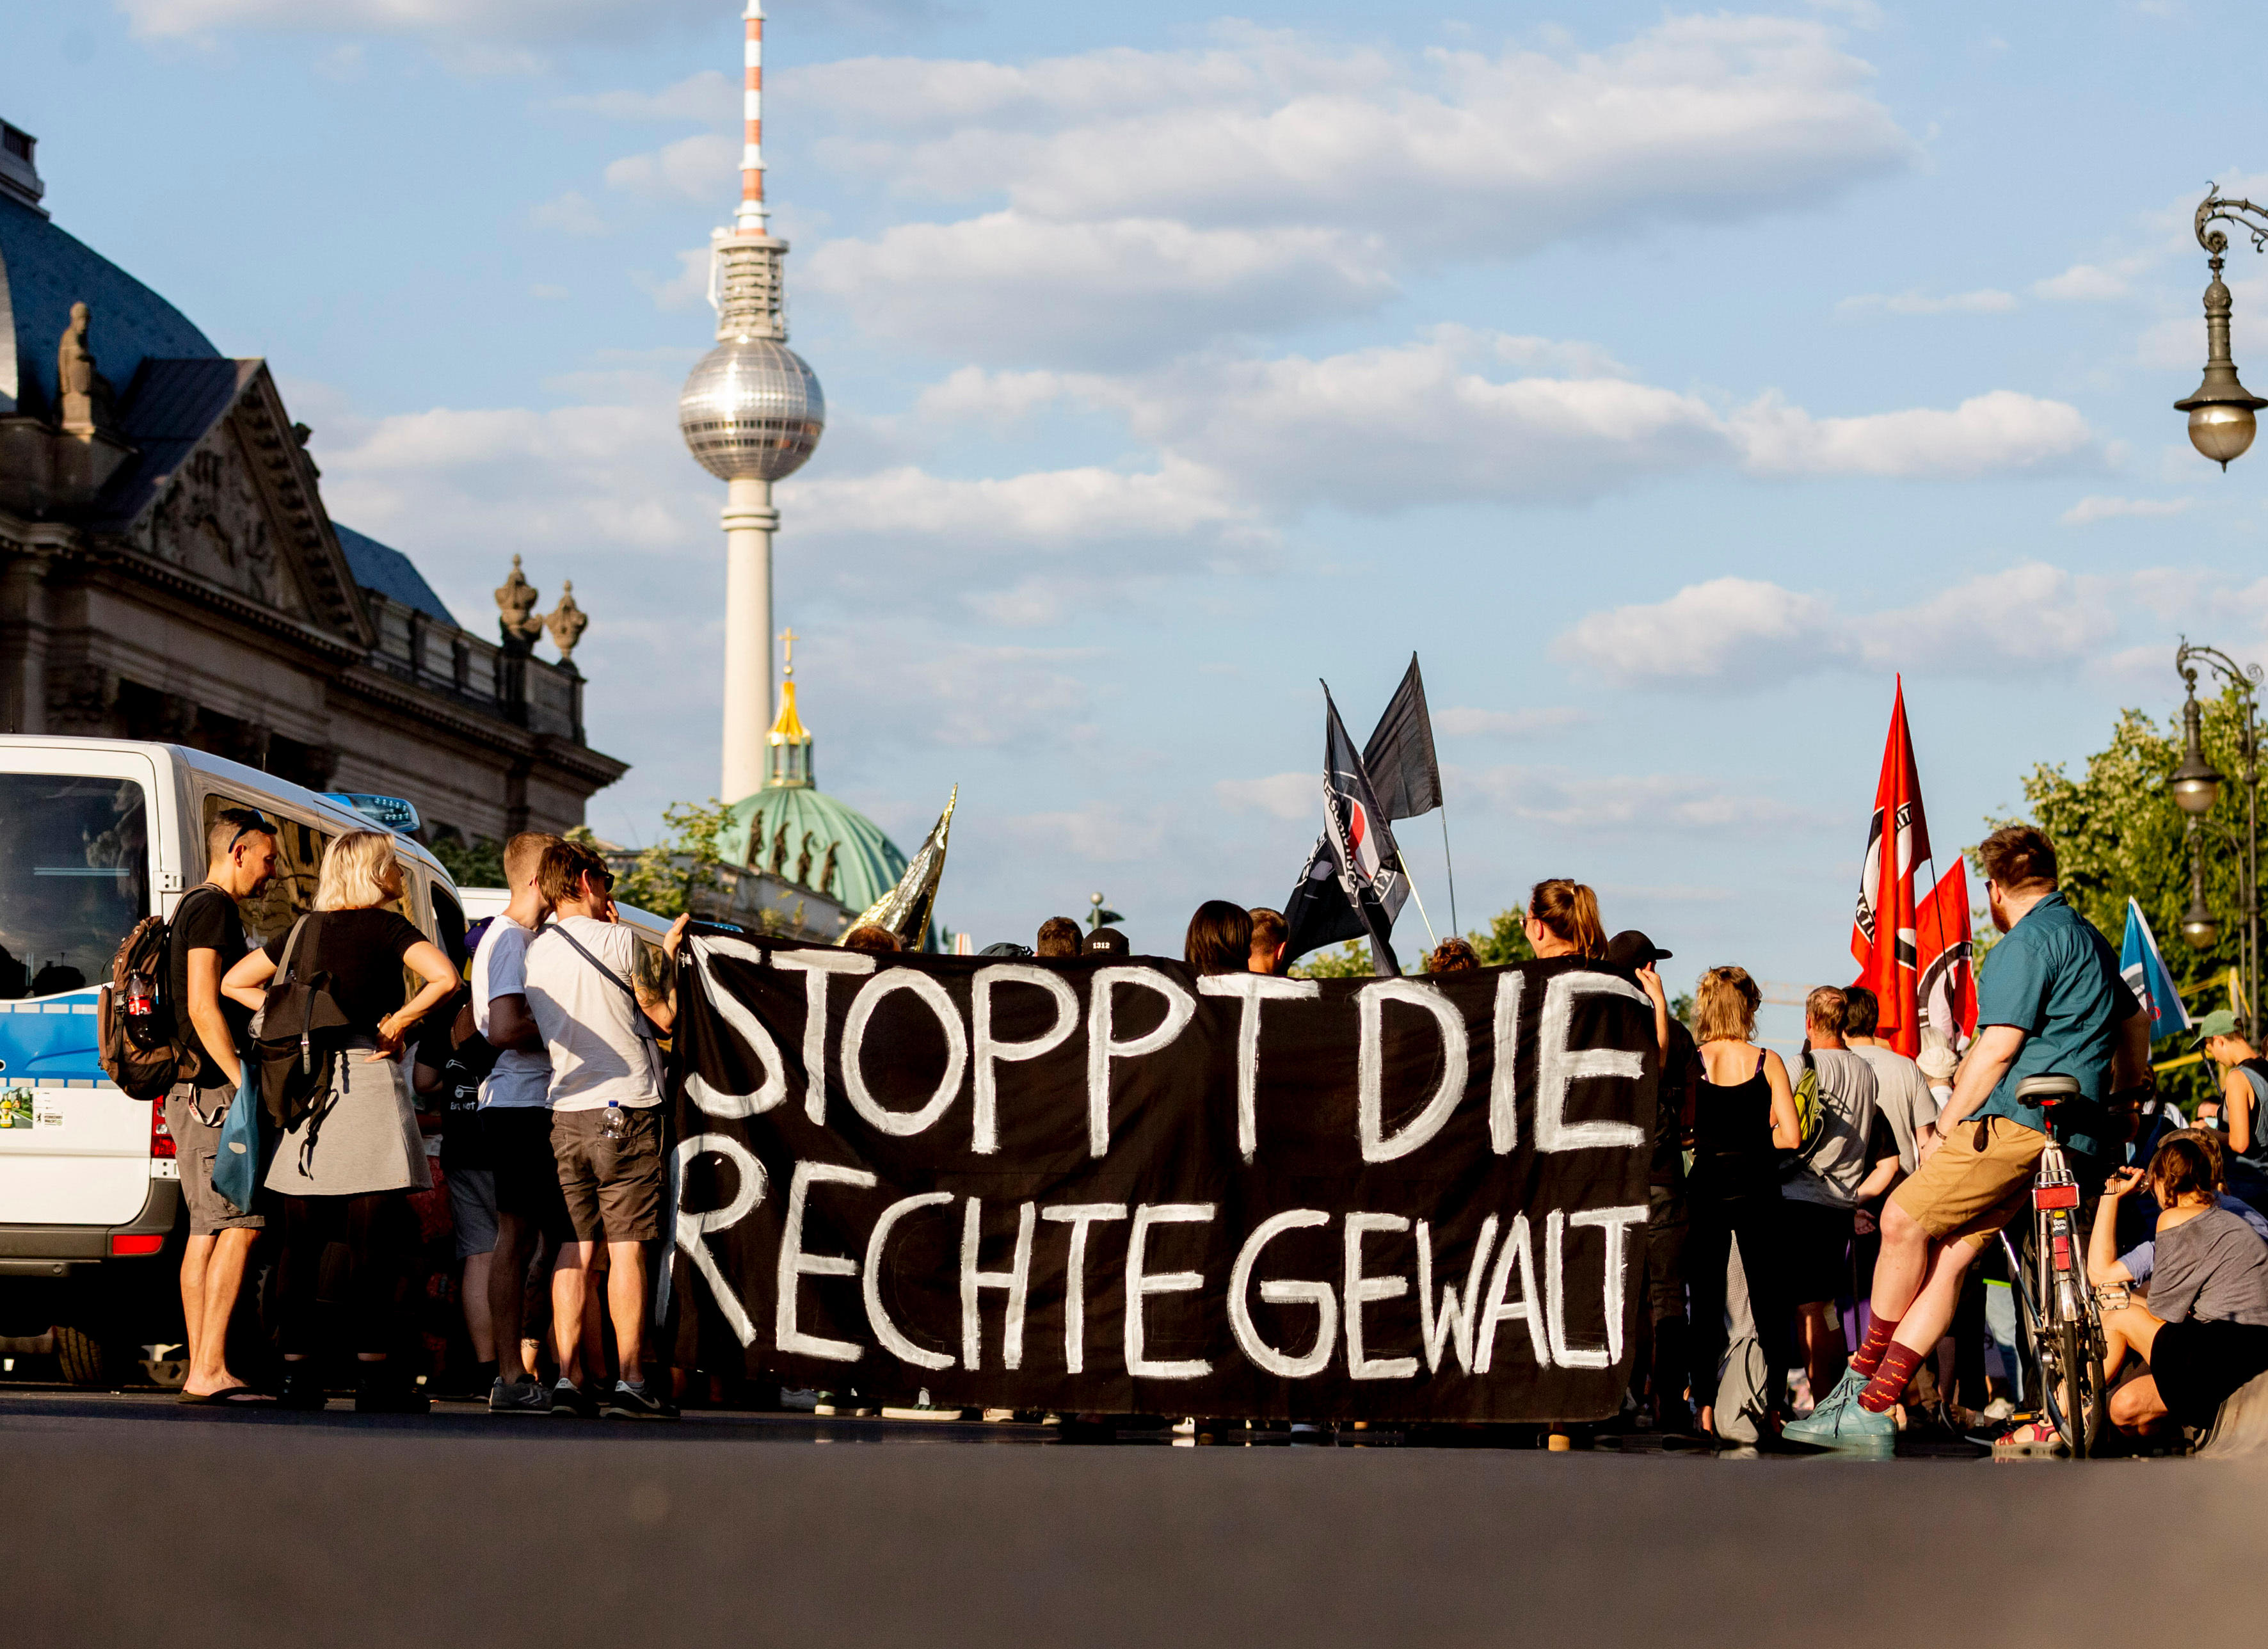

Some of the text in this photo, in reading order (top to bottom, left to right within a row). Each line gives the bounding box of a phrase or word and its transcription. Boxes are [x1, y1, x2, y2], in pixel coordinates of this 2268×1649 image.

[684, 934, 1654, 1164] STOPPT DIE
[656, 1132, 1649, 1380] RECHTE GEWALT
